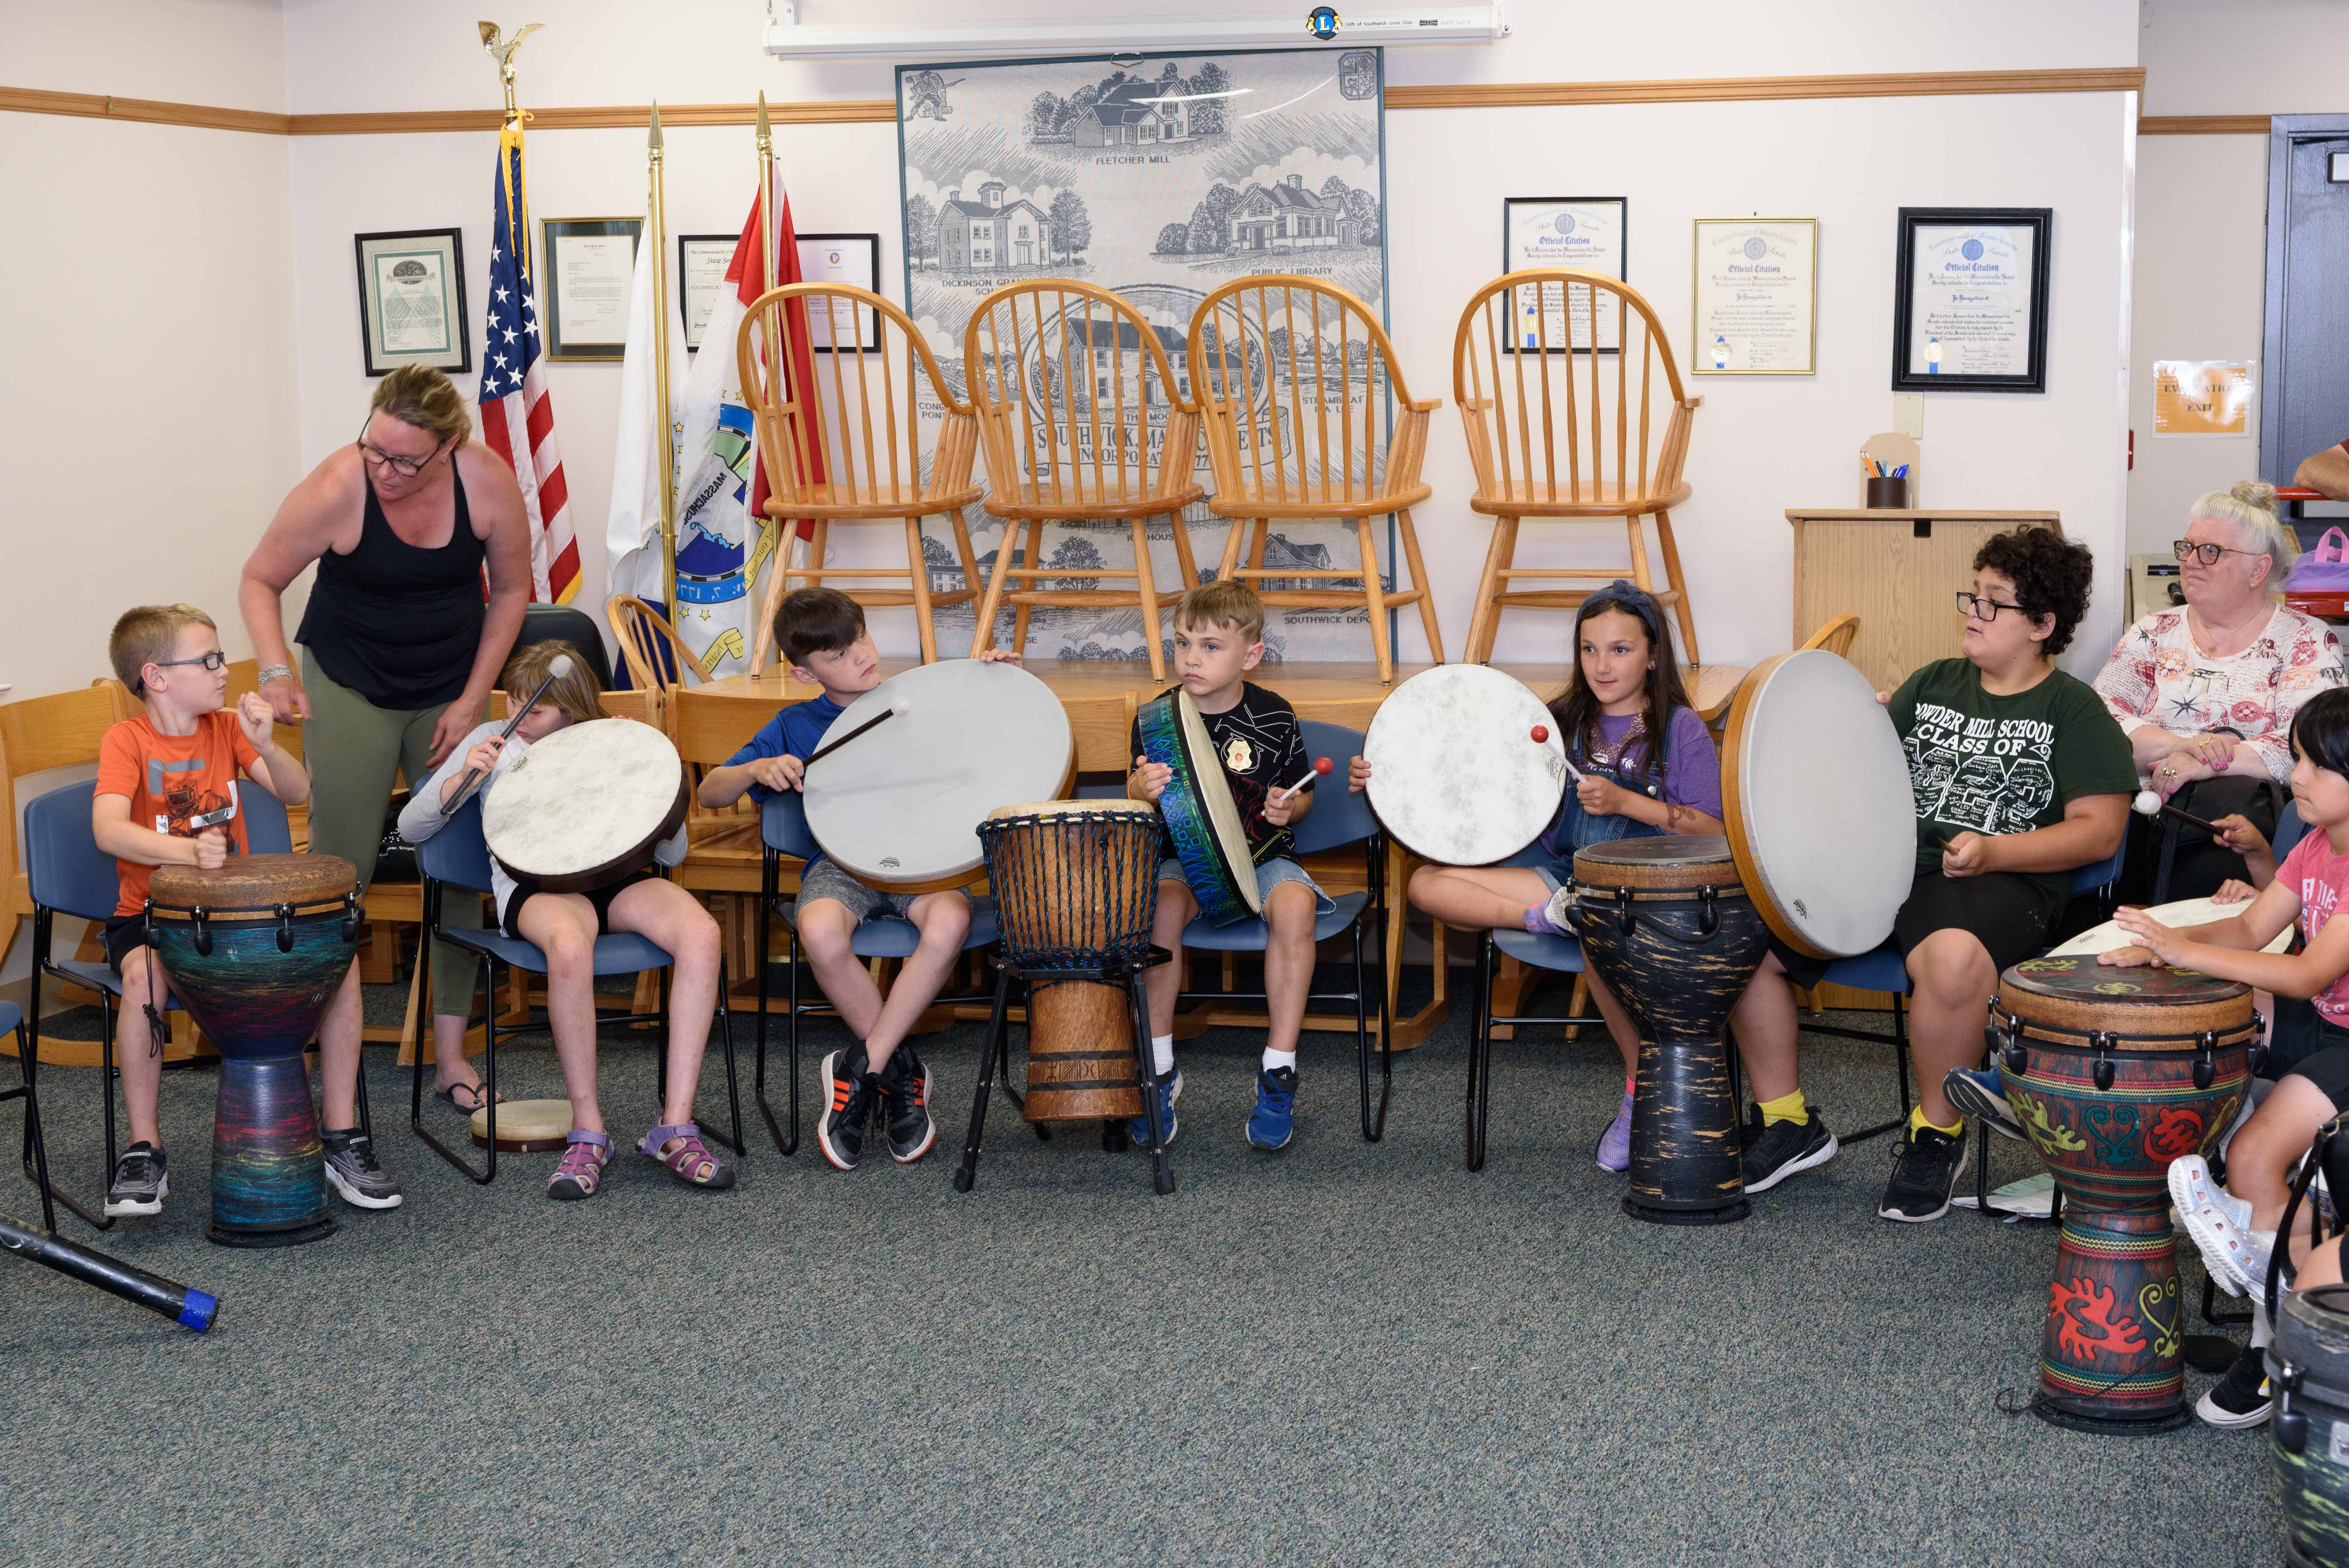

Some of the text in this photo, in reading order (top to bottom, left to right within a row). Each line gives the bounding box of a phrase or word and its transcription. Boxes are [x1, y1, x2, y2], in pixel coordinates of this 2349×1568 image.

[1320, 17, 1330, 30] L
[1096, 157, 1144, 165] FLETCHER
[1565, 236, 1590, 244] Citation
[1728, 264, 1780, 273] Official Citation
[1945, 263, 1999, 272] Official Citation
[2188, 403, 2214, 412] EXIT
[1962, 718, 1996, 738] MILL
[1997, 719, 2055, 745] SCHOOL
[1917, 724, 2026, 755] CLASS OF
